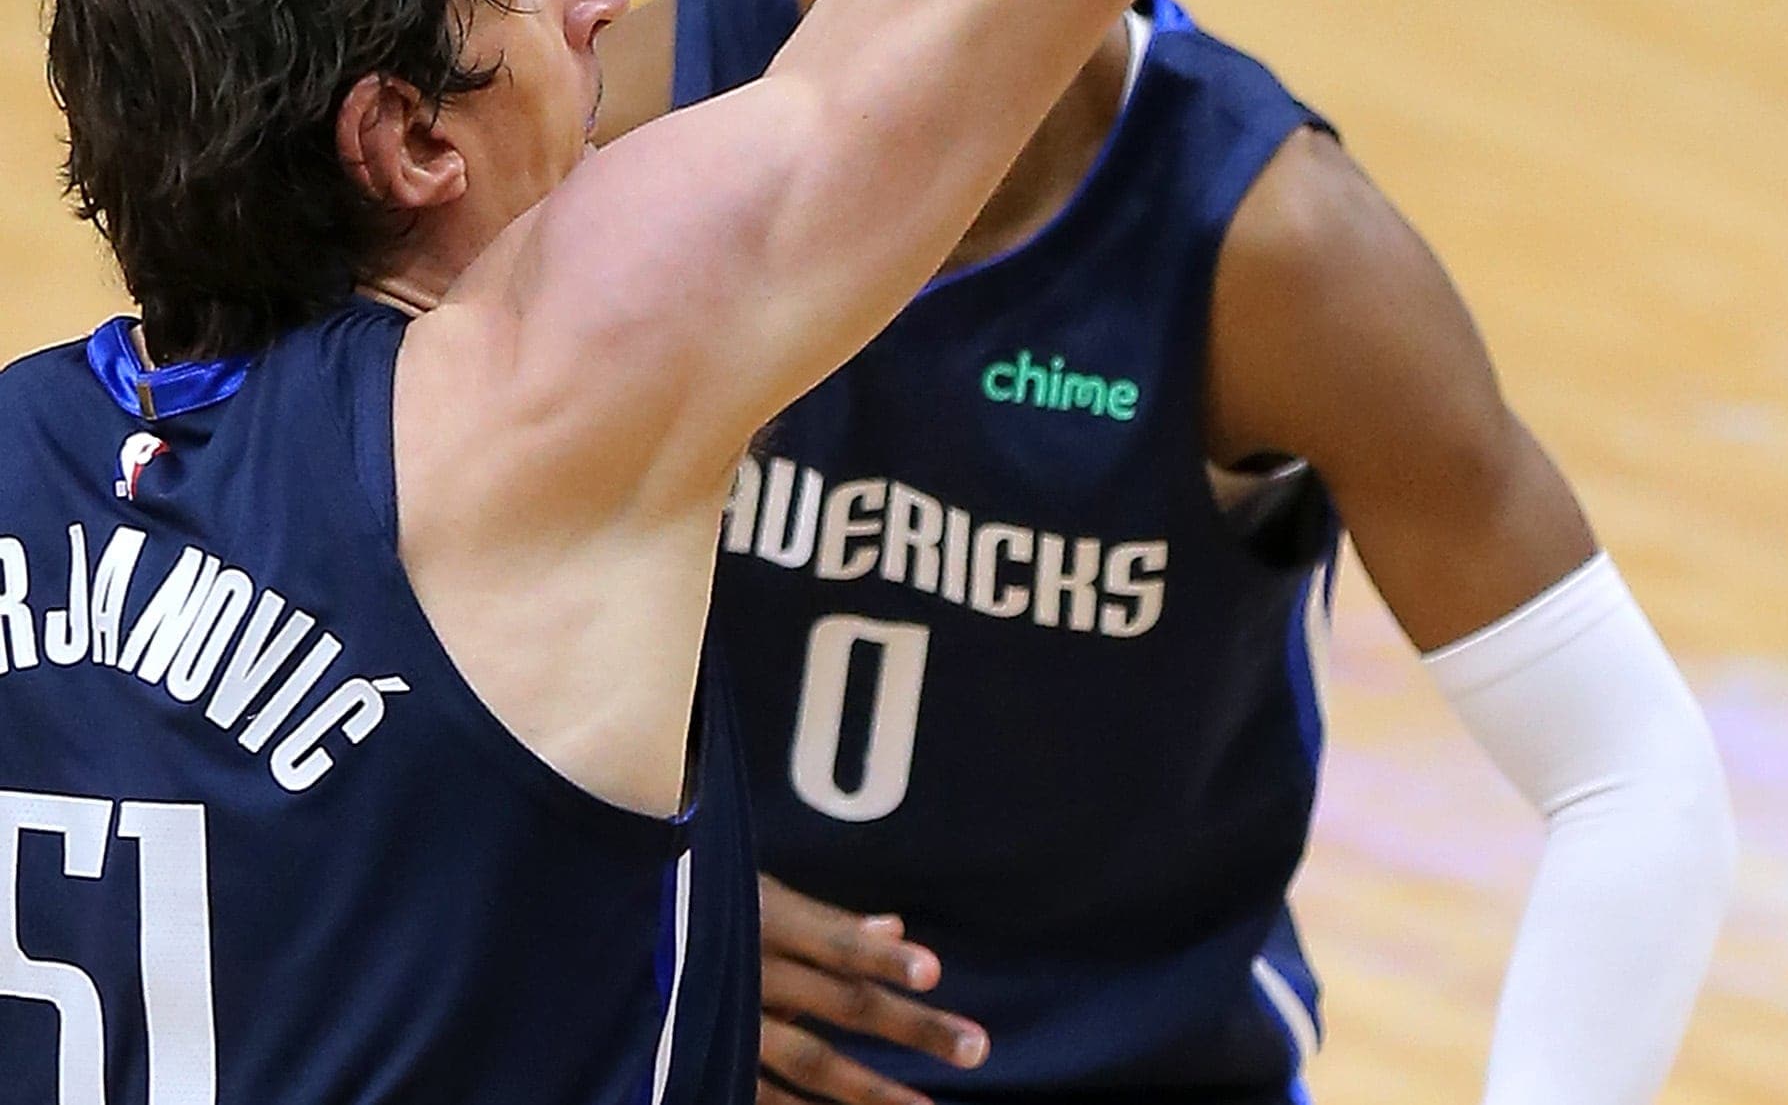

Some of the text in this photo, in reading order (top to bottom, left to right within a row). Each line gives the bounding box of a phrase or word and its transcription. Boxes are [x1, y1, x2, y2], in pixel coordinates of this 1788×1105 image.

[982, 348, 1139, 420] chime
[790, 614, 931, 822] 0
[0, 789, 217, 1105] 51
